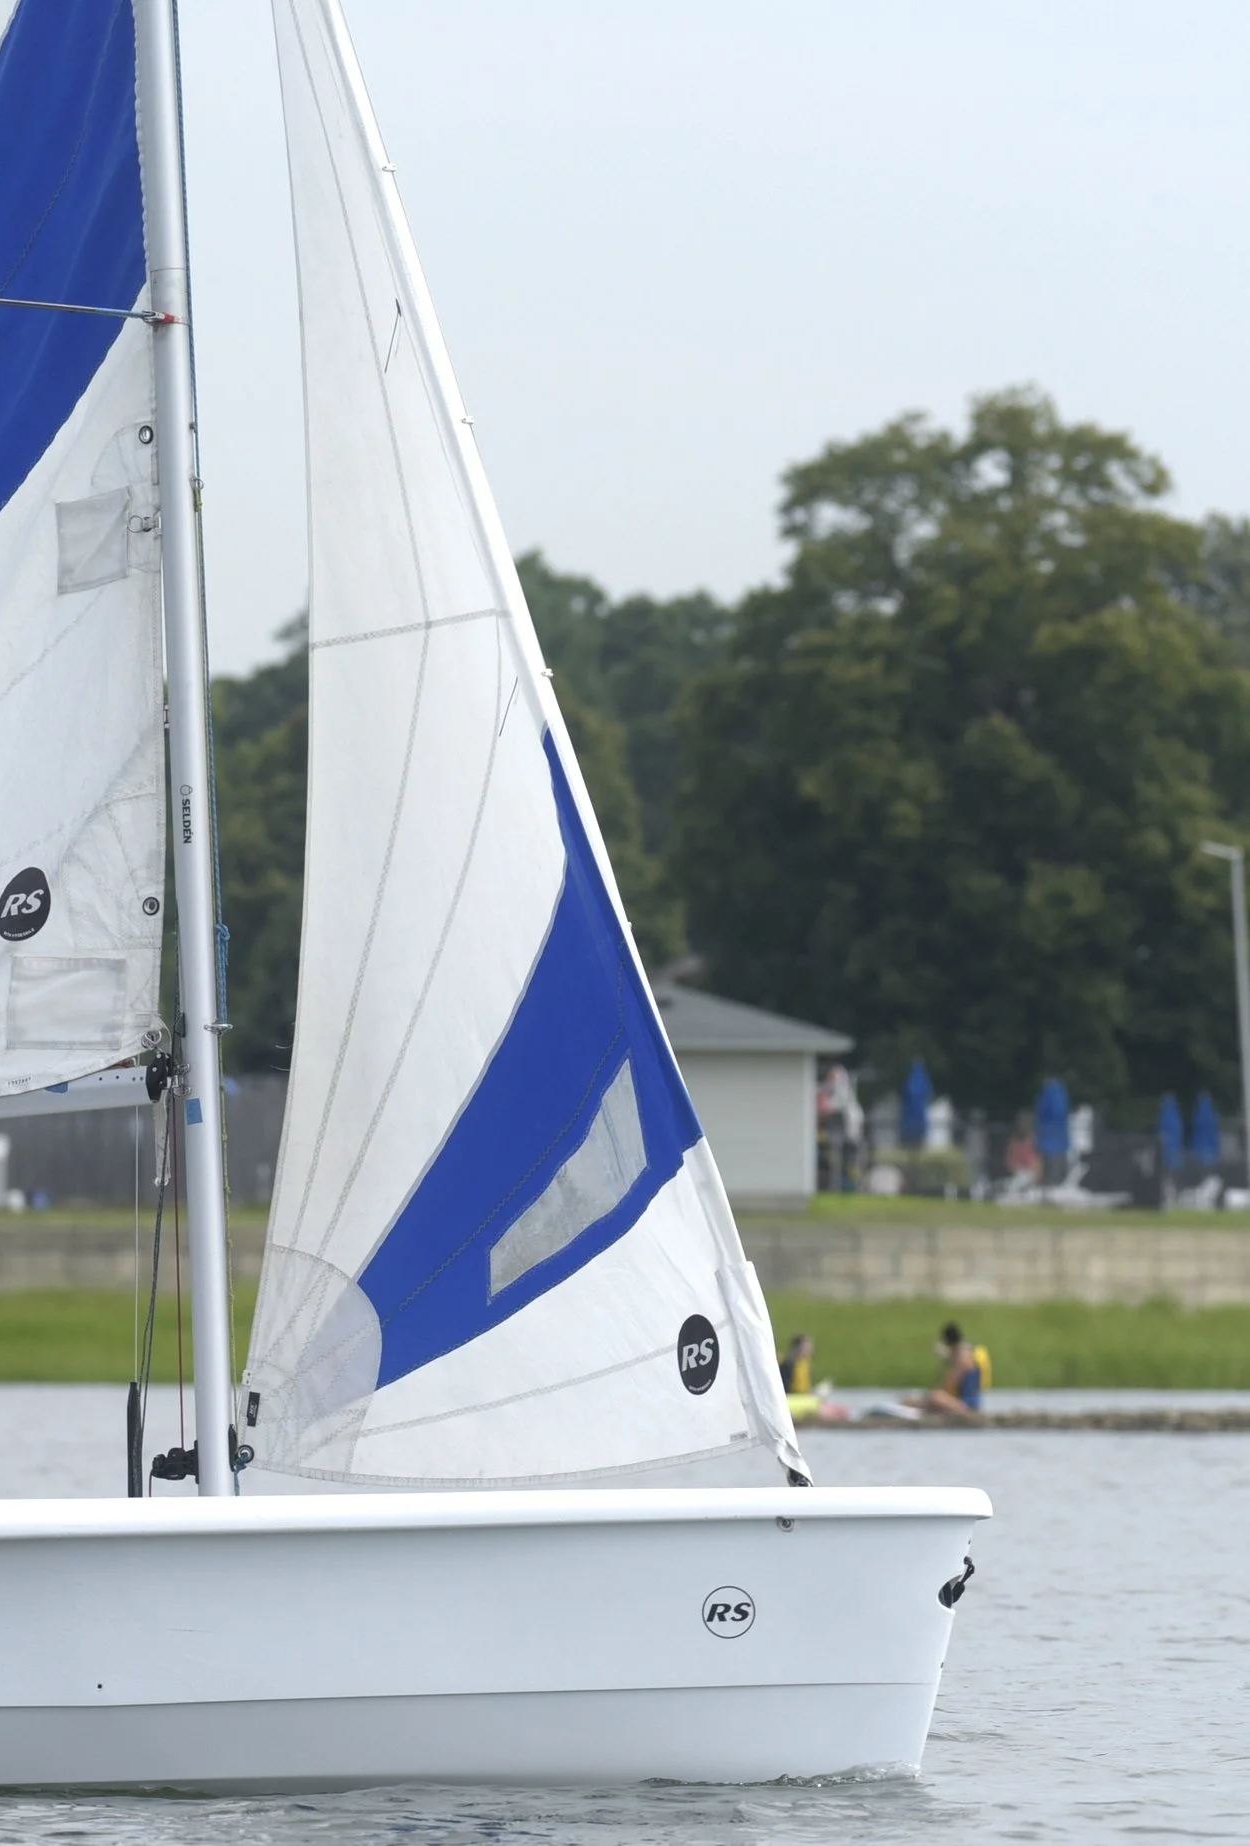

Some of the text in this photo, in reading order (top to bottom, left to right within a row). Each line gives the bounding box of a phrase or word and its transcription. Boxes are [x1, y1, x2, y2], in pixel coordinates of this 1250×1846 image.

[181, 798, 194, 844] SELDÉN
[0, 888, 45, 919] RS
[681, 1337, 715, 1372] RS
[706, 1602, 752, 1623] RS
